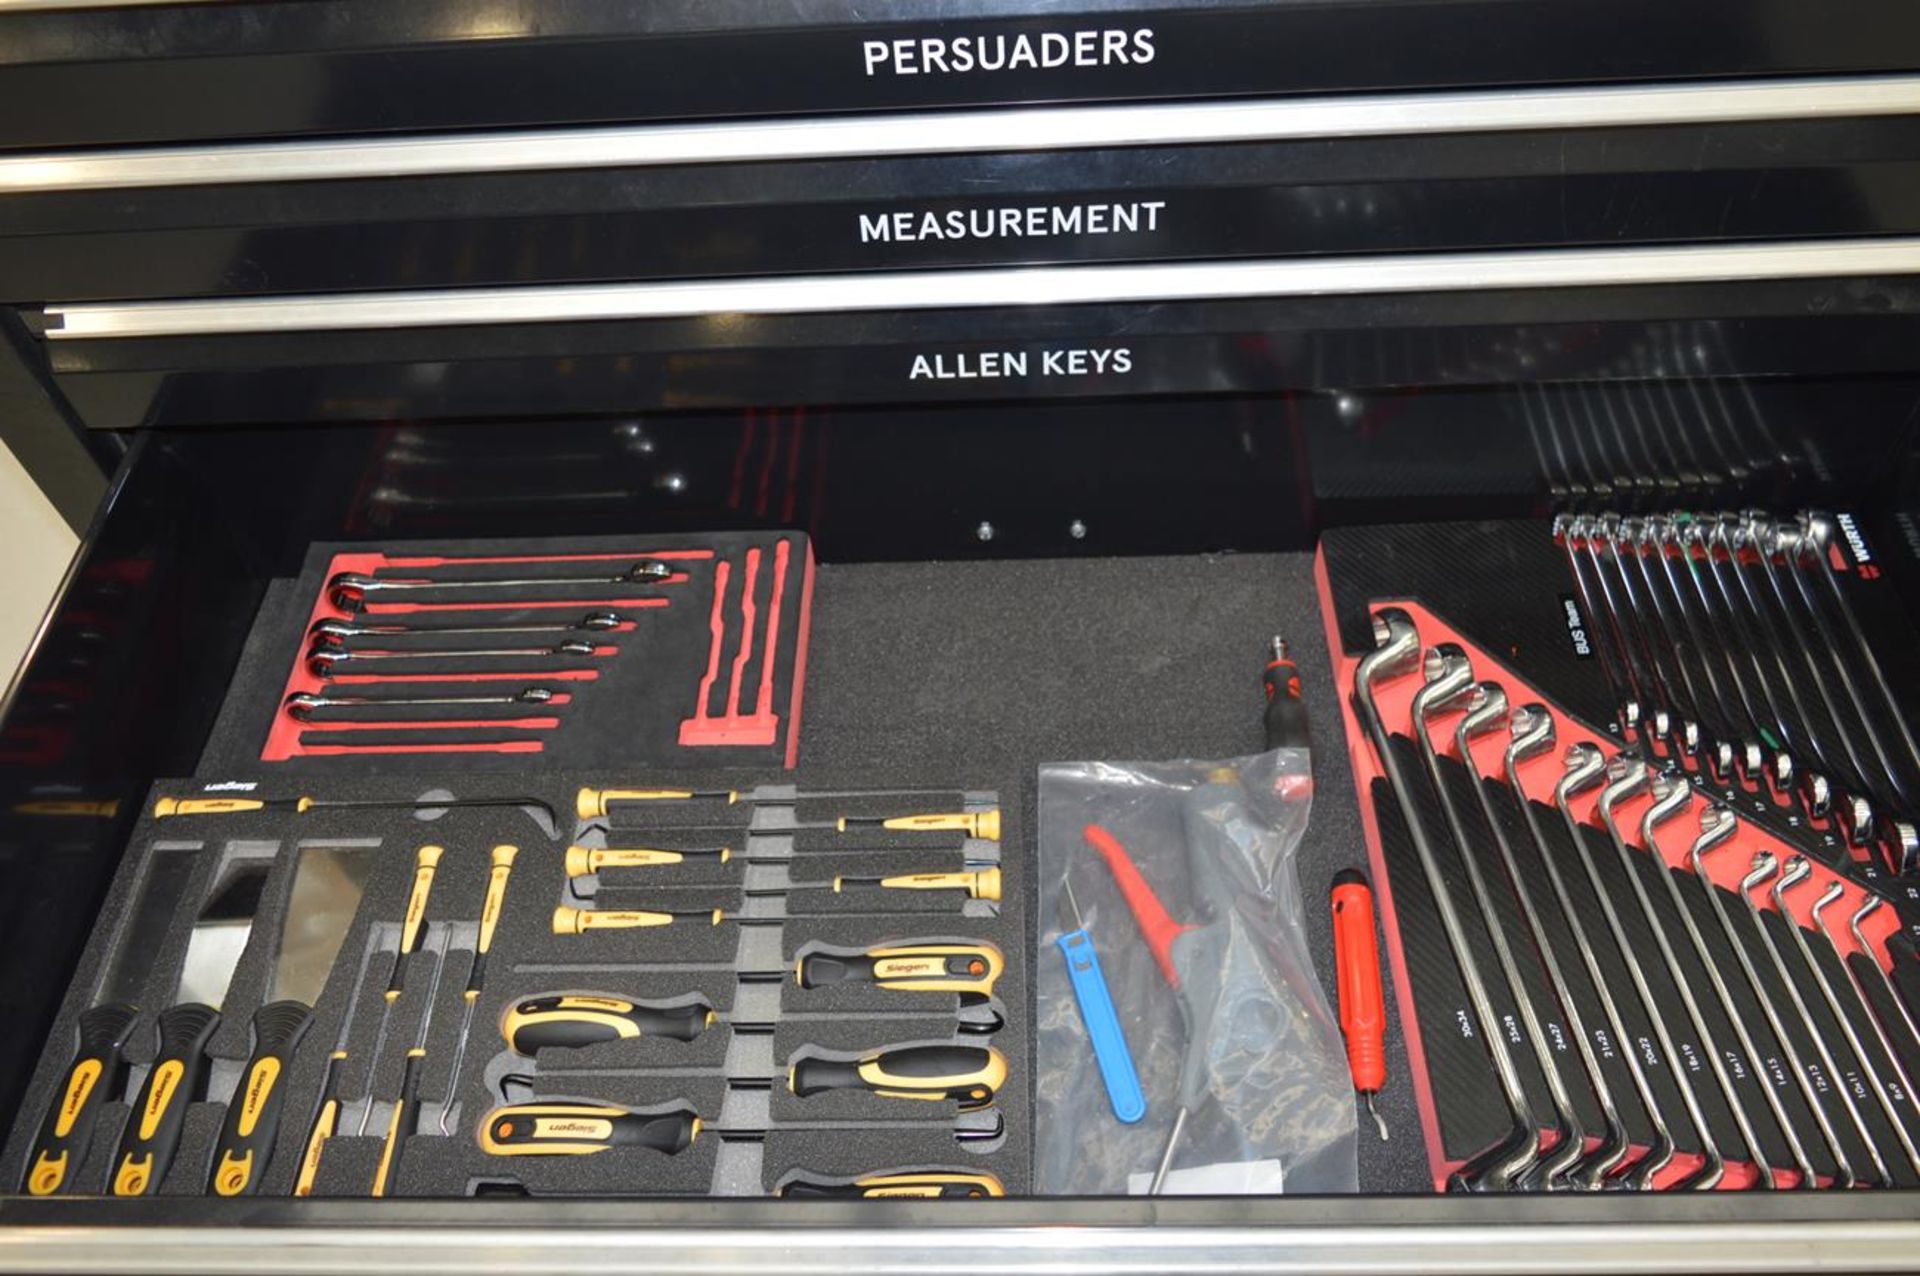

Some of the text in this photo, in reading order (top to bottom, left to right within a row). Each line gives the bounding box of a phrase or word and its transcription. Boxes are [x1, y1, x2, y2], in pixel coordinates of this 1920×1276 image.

[863, 29, 1156, 76] PERSUADERS
[859, 201, 1166, 243] MEASUREMENT
[909, 348, 1132, 380] ALLEN KEYS
[1571, 630, 1590, 655] BUS
[204, 781, 258, 791] Siegen
[885, 963, 931, 974] Siegen
[1456, 1009, 1473, 1038] 30x34
[1503, 1015, 1522, 1044] 25x28
[1548, 1022, 1567, 1051] 24x27
[1595, 1029, 1613, 1058] 21x23
[1638, 1037, 1658, 1066] 20x22
[1681, 1043, 1700, 1072] 18x19
[1725, 1051, 1746, 1079] 16x17
[1767, 1057, 1787, 1086] 14x15
[1808, 1064, 1829, 1092] 12x13
[67, 1072, 91, 1115] Siegen
[150, 1070, 173, 1116] Siegen
[248, 1069, 268, 1115] Siegen
[1846, 1071, 1866, 1099] 10x11
[1888, 1082, 1904, 1101] 8x9
[548, 1123, 597, 1134] Siegen
